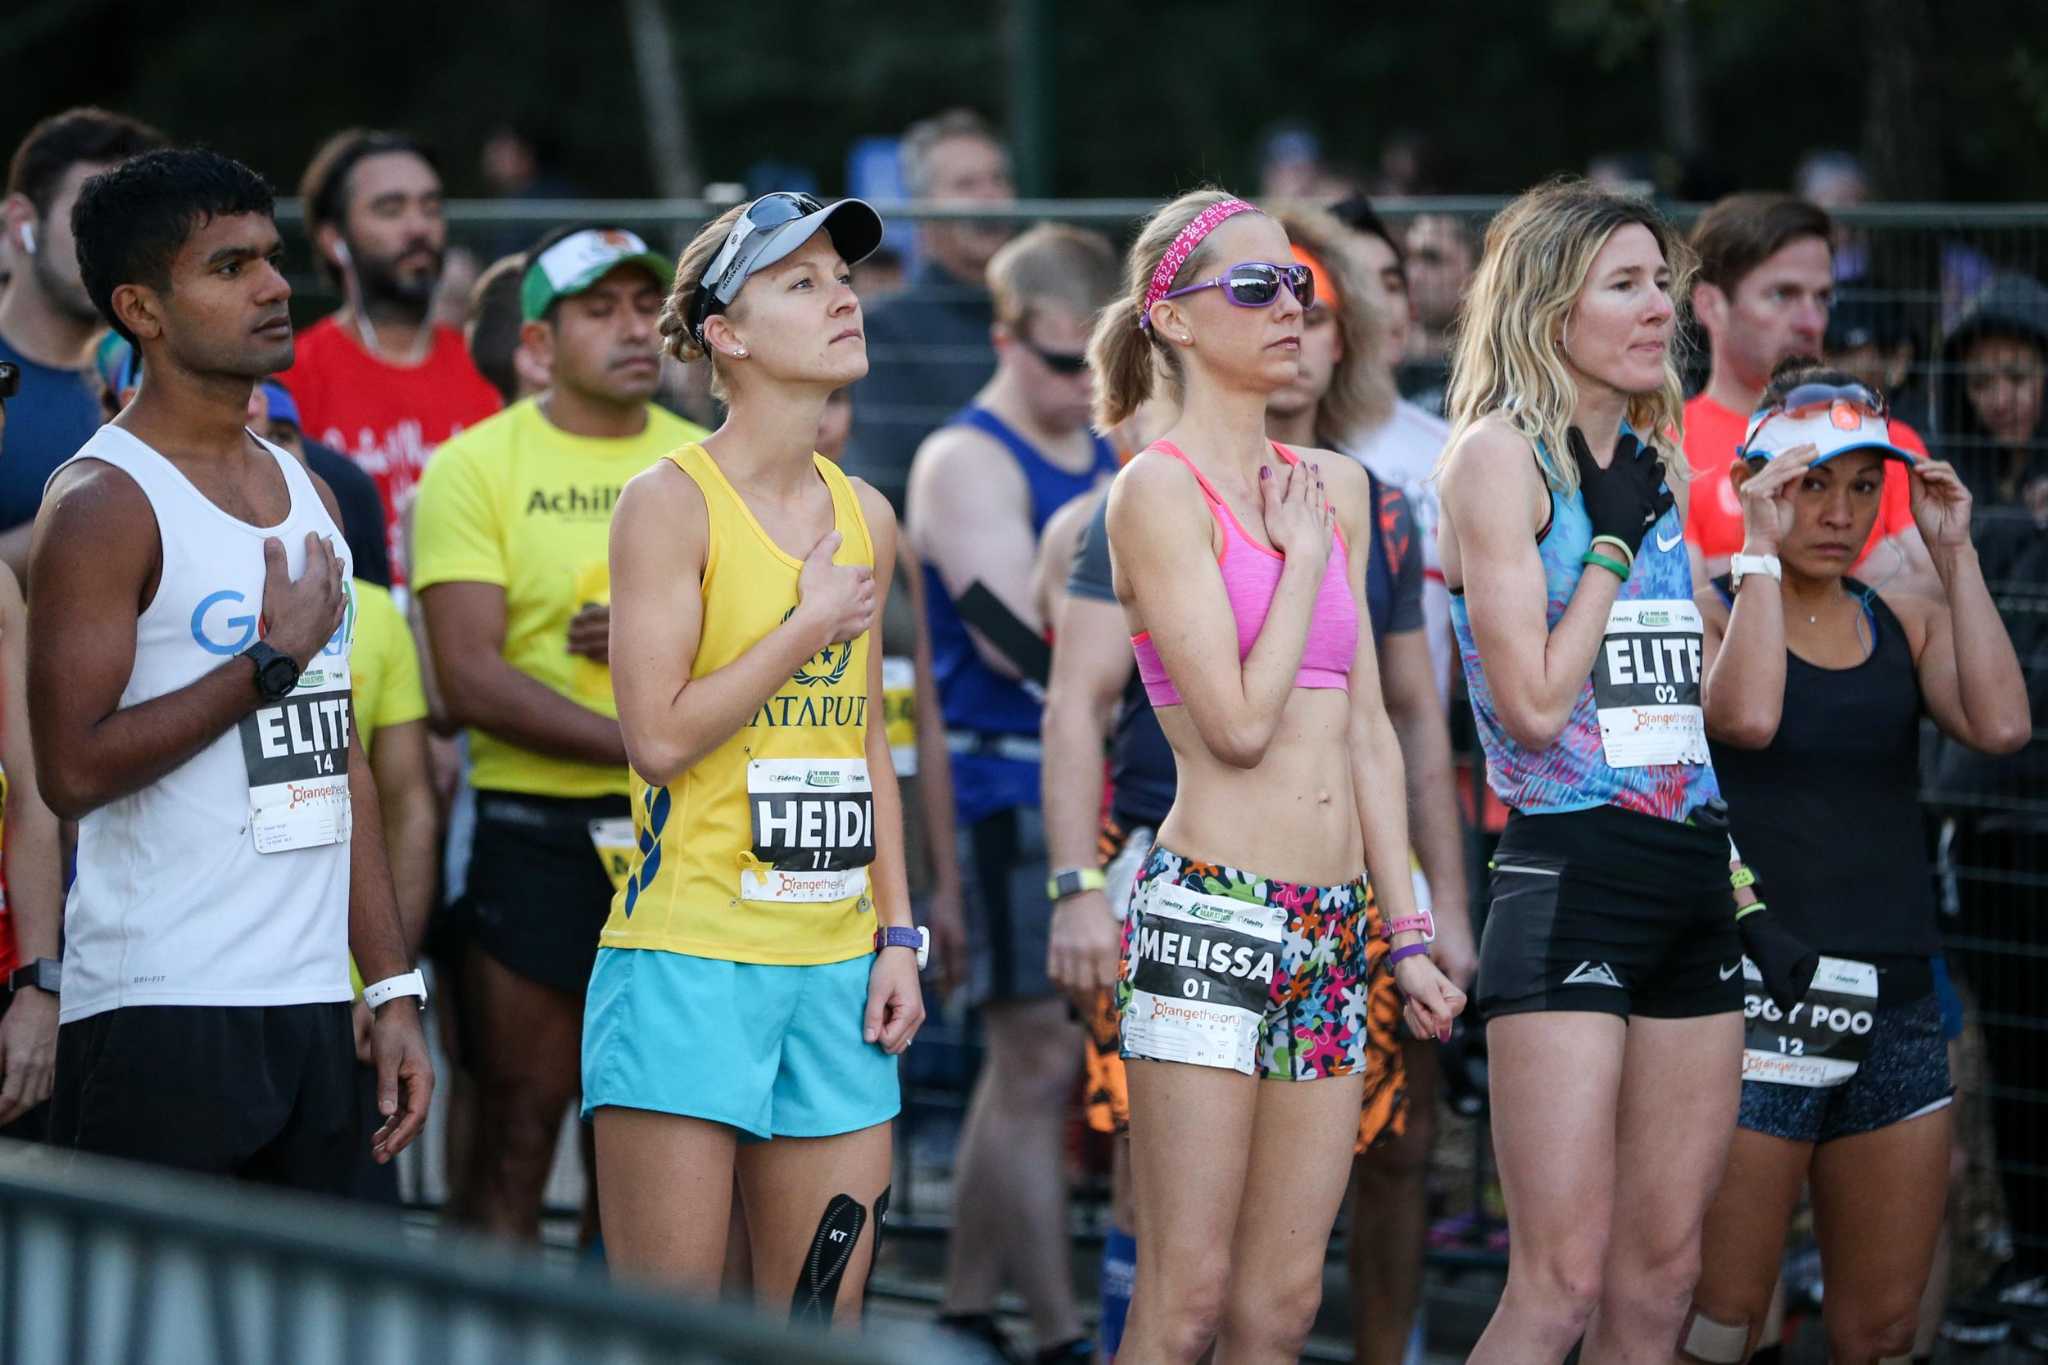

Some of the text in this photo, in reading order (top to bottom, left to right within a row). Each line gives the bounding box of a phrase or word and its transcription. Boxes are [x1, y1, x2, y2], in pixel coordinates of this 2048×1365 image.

[1605, 638, 1701, 685] ELITE
[1655, 685, 1678, 703] 02
[255, 698, 350, 759] ELITE
[314, 753, 334, 774] 14
[758, 801, 872, 848] HEIDI
[812, 851, 832, 869] 11
[1139, 927, 1274, 985] MELISSA
[1183, 978, 1210, 1000] 01
[1153, 997, 1241, 1026] Orangetheory
[1810, 1005, 1874, 1035] POO
[1778, 1035, 1804, 1056] 12
[829, 1229, 847, 1243] KT
